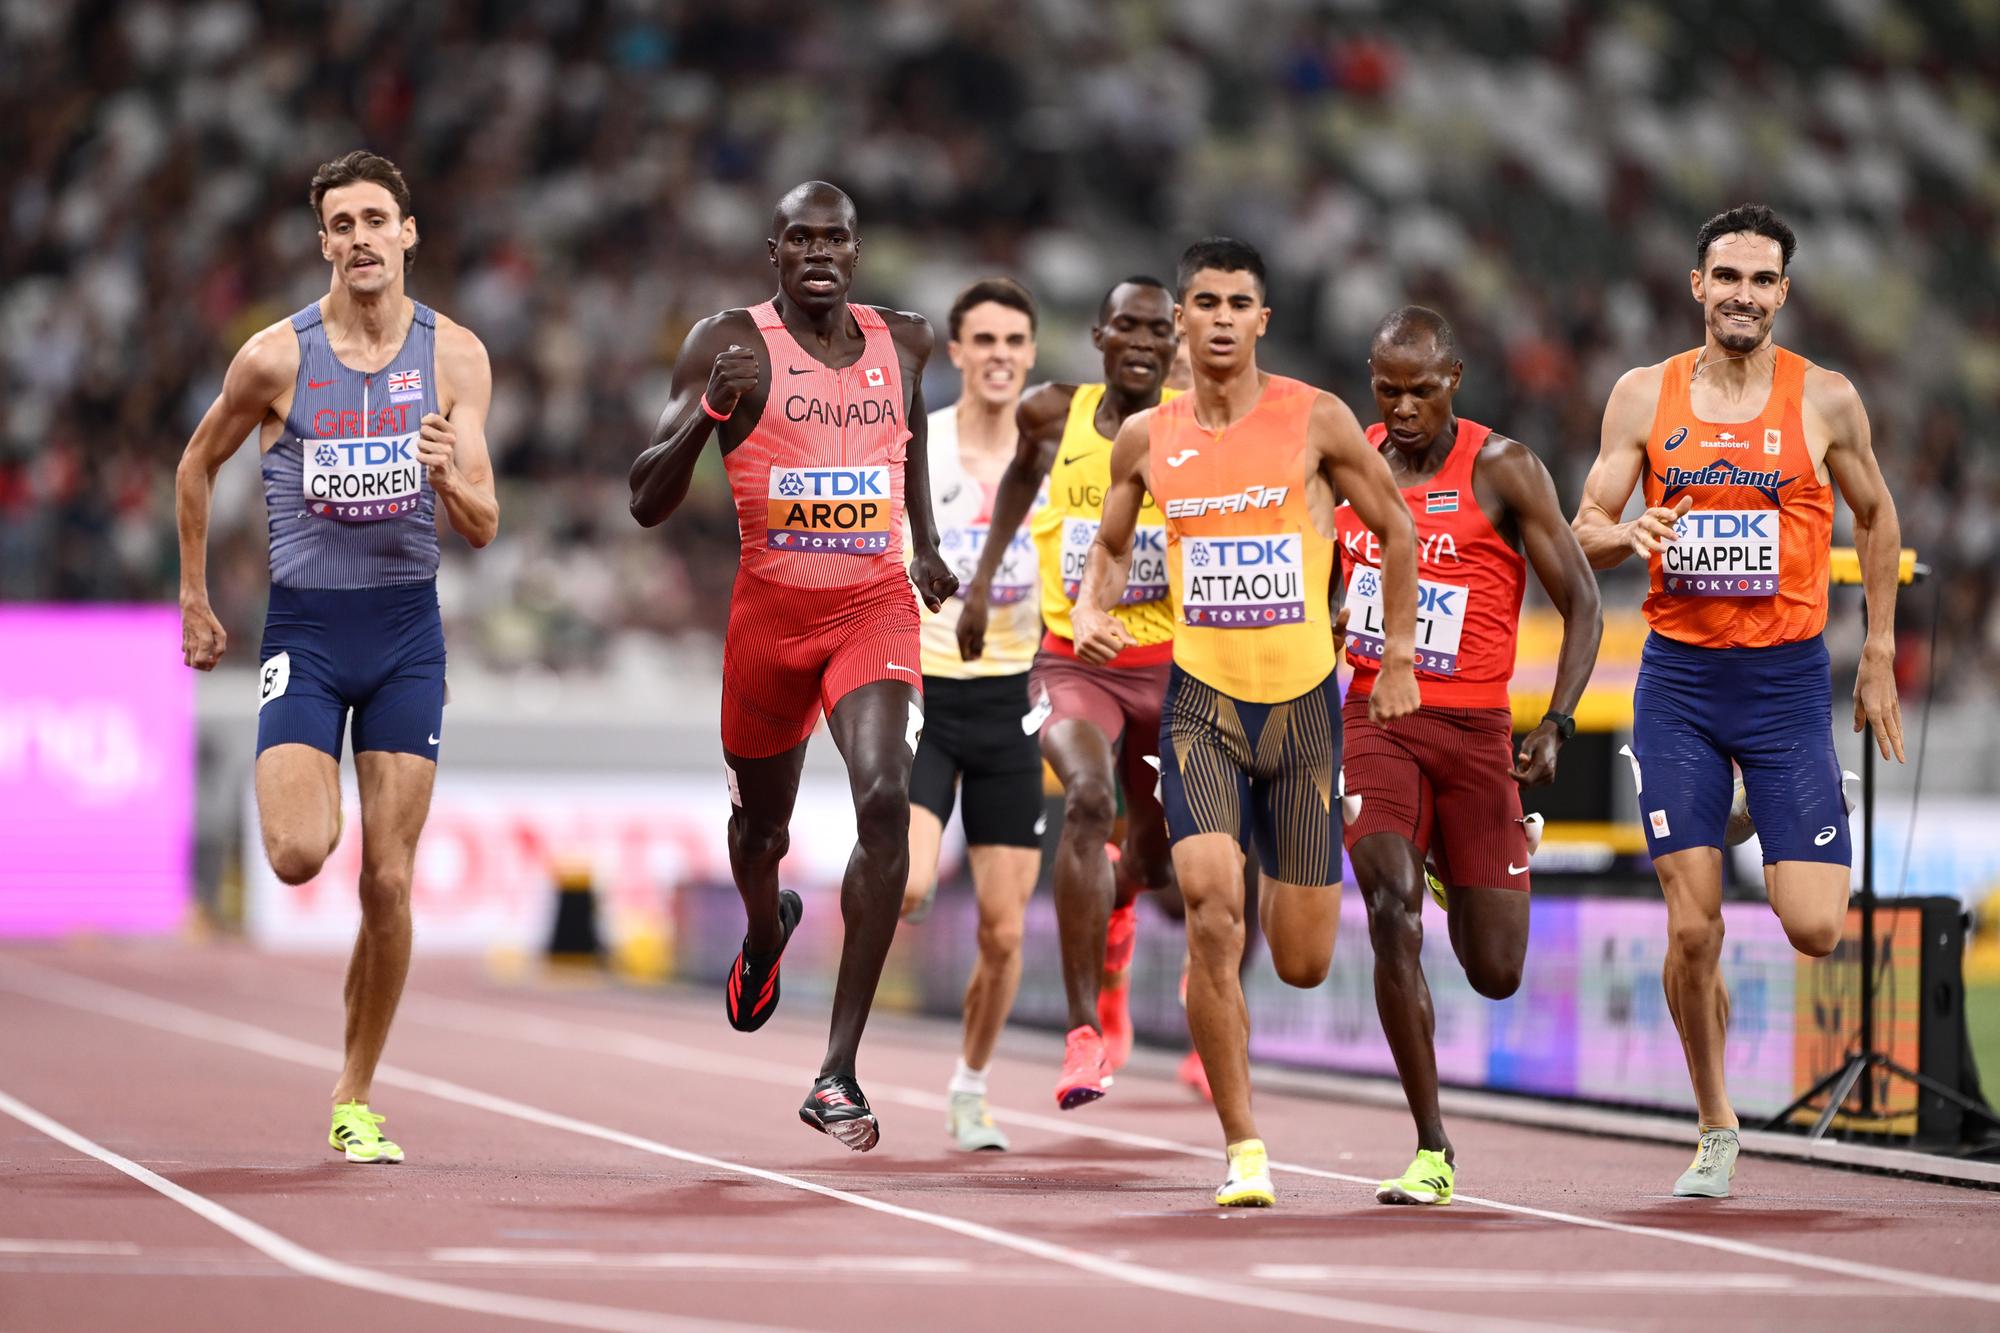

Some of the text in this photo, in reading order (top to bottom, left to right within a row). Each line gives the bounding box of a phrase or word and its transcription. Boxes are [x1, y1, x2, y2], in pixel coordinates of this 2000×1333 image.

[313, 404, 412, 437] GREAT
[785, 395, 897, 428] CANADA
[338, 437, 413, 466] TDK
[1700, 441, 1750, 449] Staatsloterij
[311, 466, 416, 498] CRORKEN
[804, 470, 882, 496] TDK
[785, 503, 878, 529] AROP
[1165, 485, 1289, 519] ESPAÑA
[964, 530, 1031, 550] TK
[1688, 514, 1768, 539] TDK
[1210, 539, 1292, 567] TDK
[1344, 530, 1460, 563] KEYA
[1666, 545, 1772, 572] CHAPPLE
[1190, 572, 1297, 601] ATTAOUI
